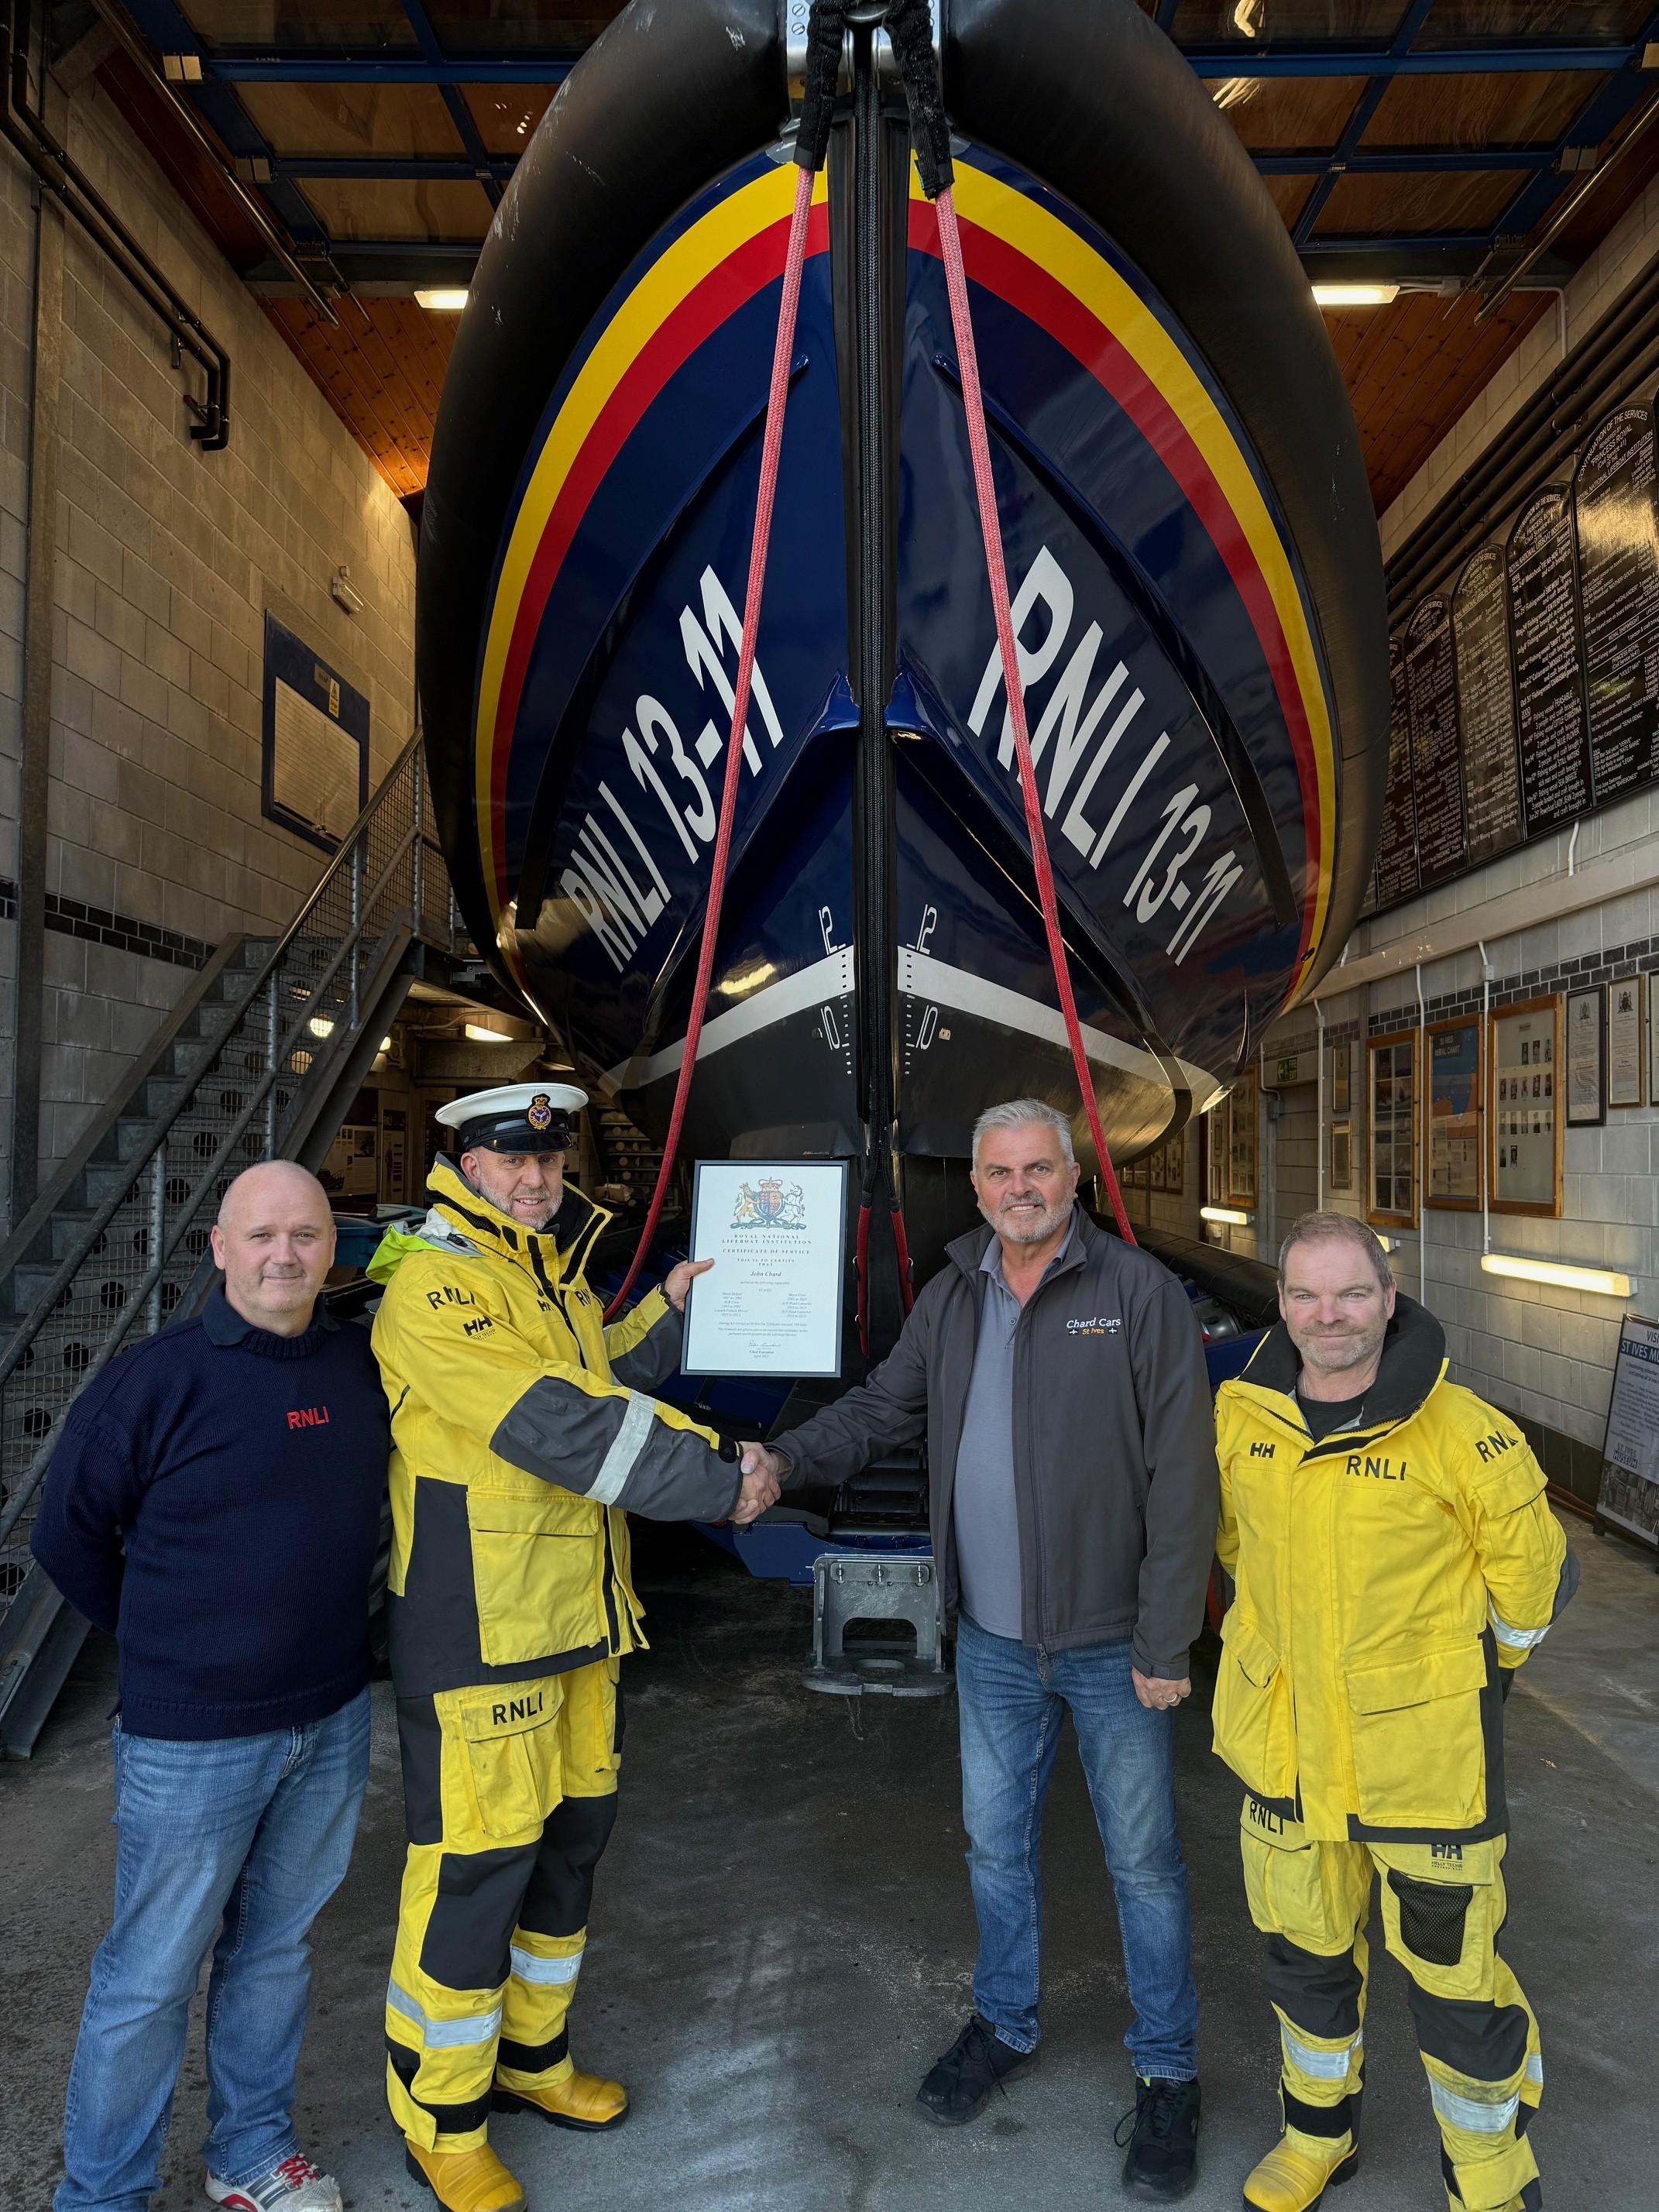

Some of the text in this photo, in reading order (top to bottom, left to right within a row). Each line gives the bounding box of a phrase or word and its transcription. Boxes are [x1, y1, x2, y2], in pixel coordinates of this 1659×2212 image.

[1589, 472, 1607, 491] NATIONAL
[1607, 453, 1626, 475] LIFEBOAT
[1626, 429, 1652, 457] INSTITUTION
[967, 544, 1243, 966] RNLI 13-11
[560, 564, 784, 974] RNLI 13-11
[462, 1315, 493, 1336] HH
[1066, 1317, 1121, 1328] Chard Cars
[1621, 1340, 1631, 1353] ST
[1631, 1342, 1648, 1358] IVES
[287, 1407, 329, 1430] RNLI
[1250, 1442, 1276, 1458] HH
[1613, 1450, 1637, 1469] MUSEUM
[1346, 1455, 1407, 1481] RNLI
[493, 1692, 544, 1726] RNLI
[1250, 1800, 1283, 1836] RNLI
